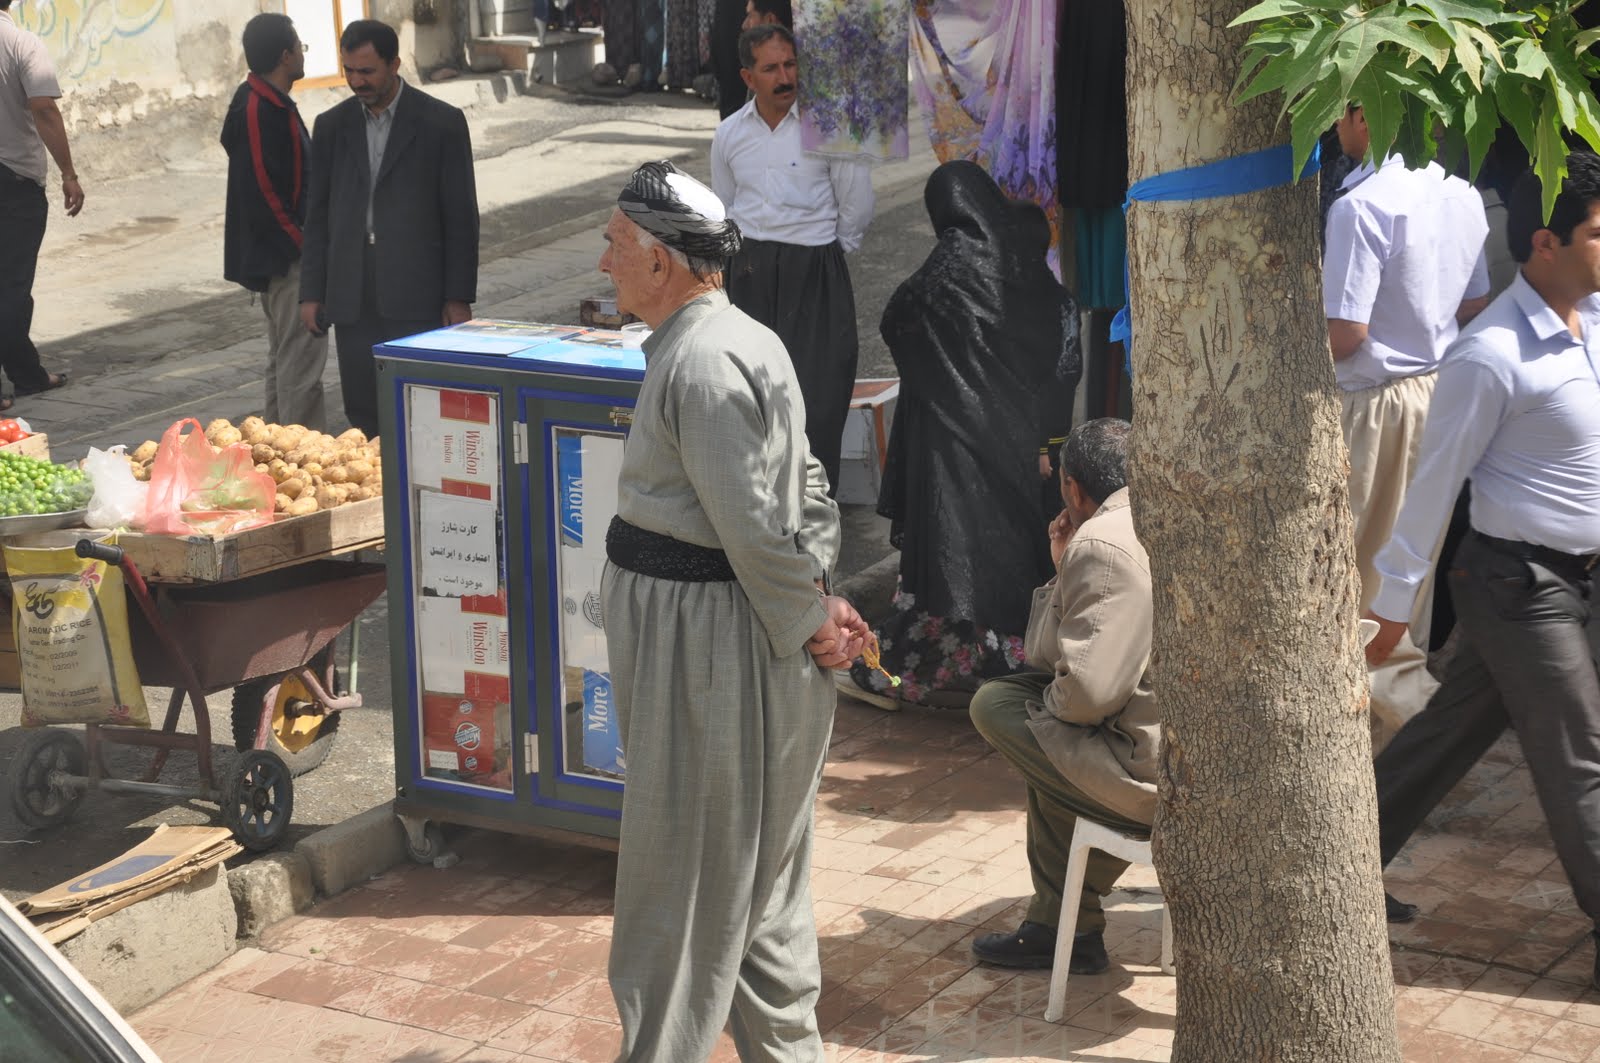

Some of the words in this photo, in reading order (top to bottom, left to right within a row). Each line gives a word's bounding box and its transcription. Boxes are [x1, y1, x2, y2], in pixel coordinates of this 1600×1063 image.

[444, 435, 453, 464] Winston
[466, 430, 480, 475] Winston
[568, 474, 583, 523] More
[459, 524, 478, 536] کارت
[28, 624, 67, 635] AROMATIC
[70, 618, 92, 629] RICE
[473, 622, 488, 665] Winston
[499, 631, 508, 662] Winston
[588, 686, 608, 734] More
